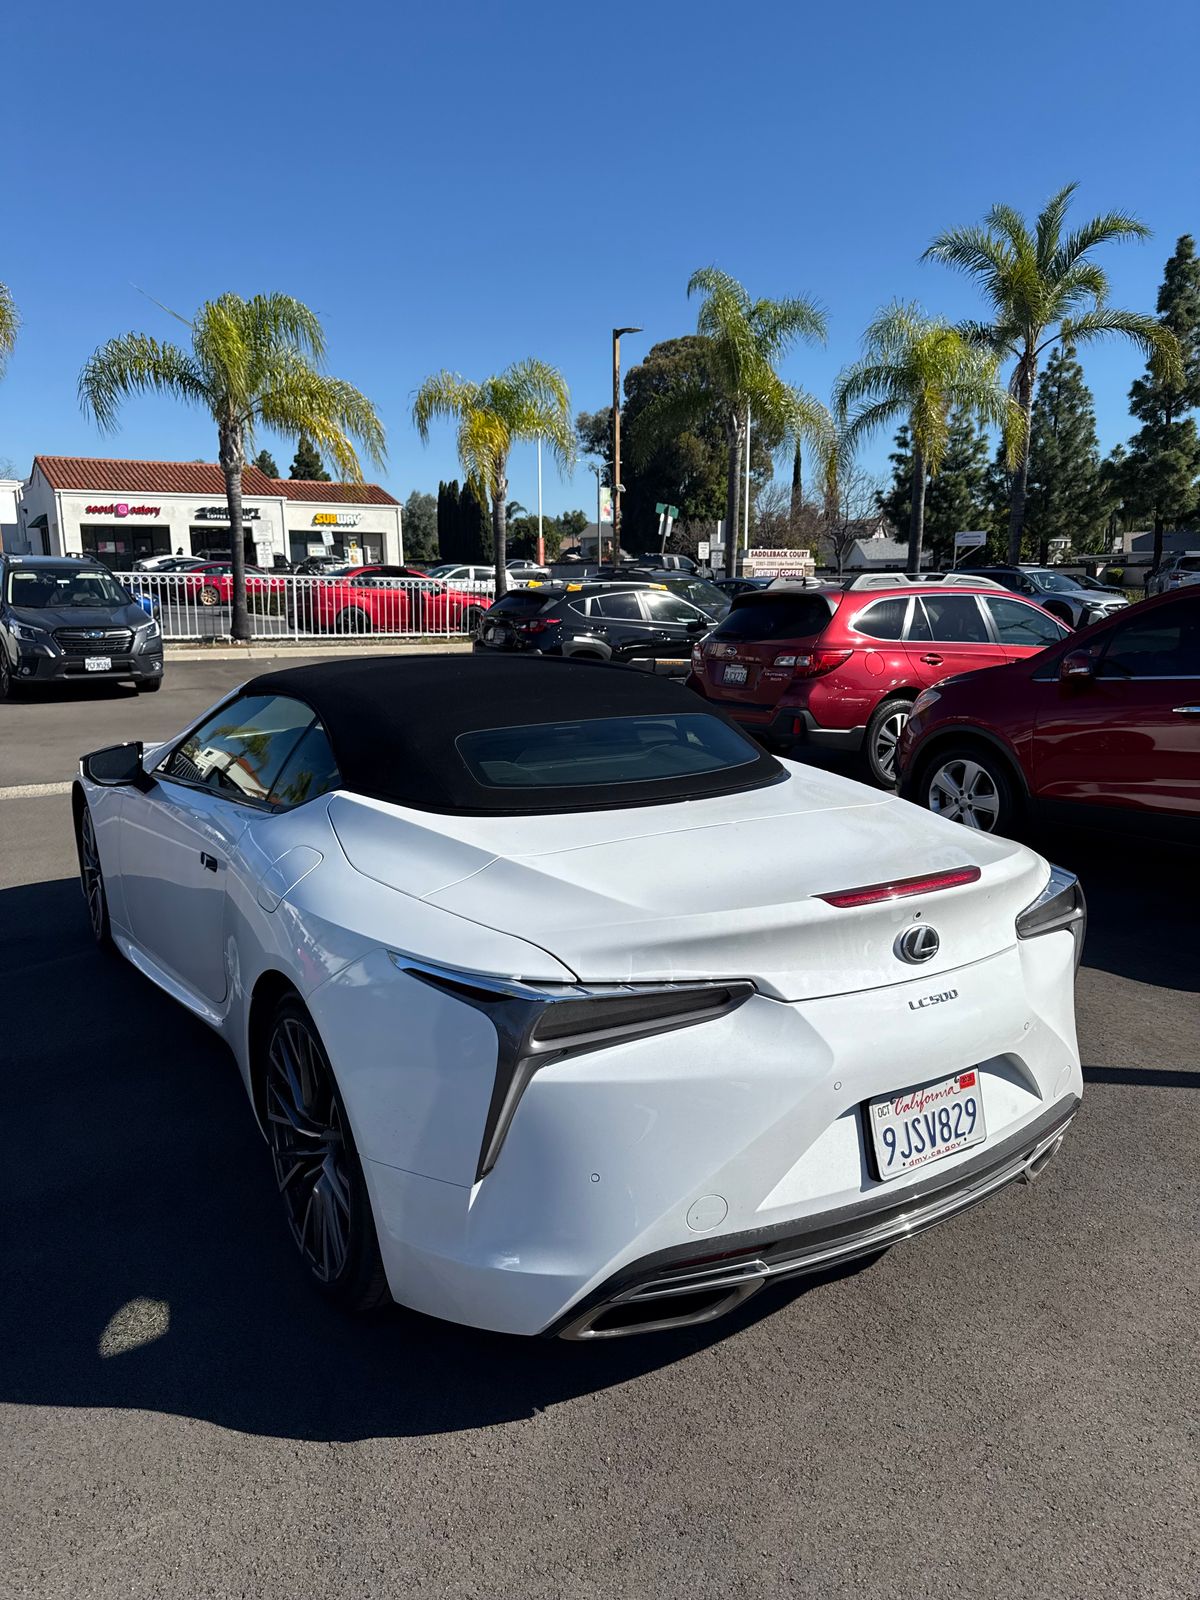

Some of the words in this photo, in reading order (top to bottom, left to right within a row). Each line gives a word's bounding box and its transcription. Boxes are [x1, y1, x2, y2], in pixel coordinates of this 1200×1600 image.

[315, 513, 361, 525] SUBWAY
[755, 569, 779, 577] DENTISTRY
[877, 1103, 891, 1118] OCT
[894, 1083, 961, 1116] California
[882, 1097, 977, 1167] 9JSV829
[908, 1141, 962, 1167] dmv.ca.gov
